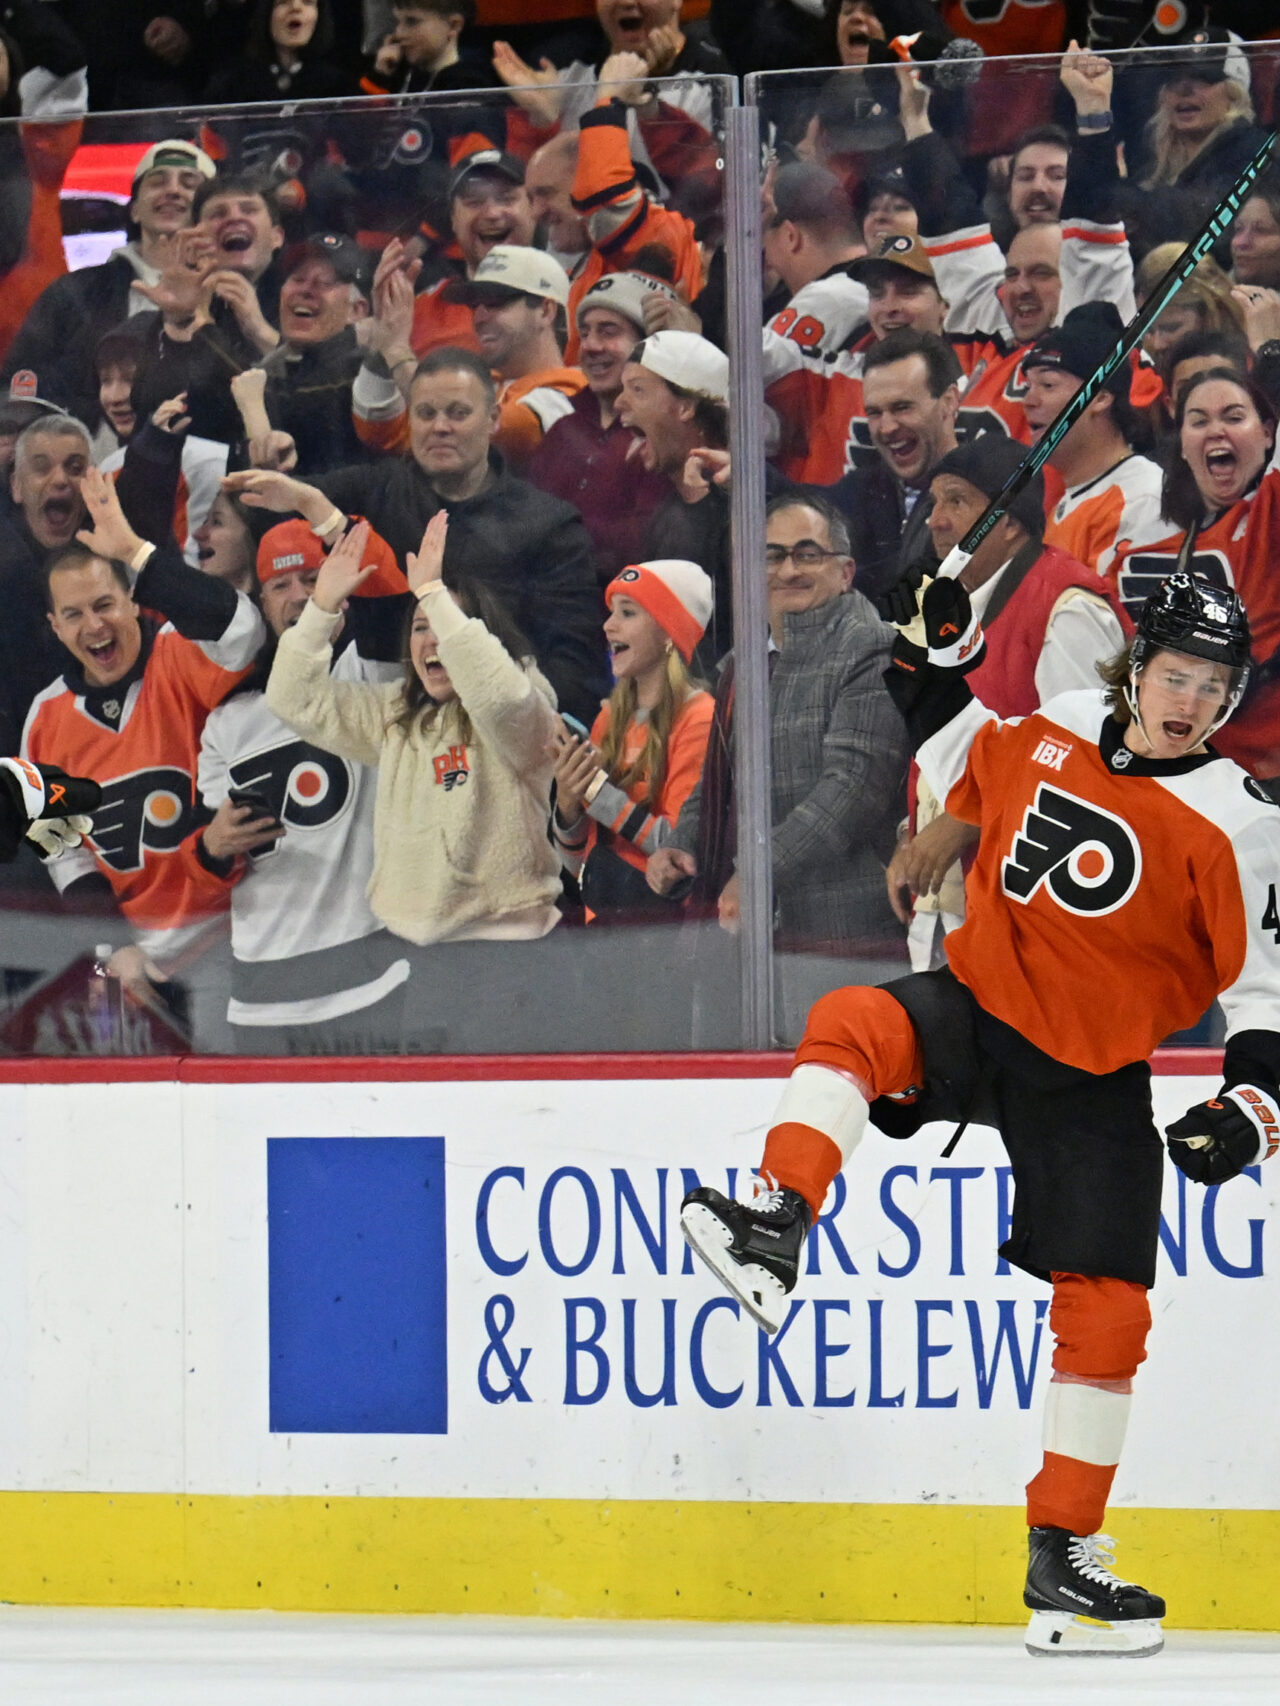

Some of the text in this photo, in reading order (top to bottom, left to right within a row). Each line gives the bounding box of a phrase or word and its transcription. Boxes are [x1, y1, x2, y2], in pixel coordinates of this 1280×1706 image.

[1030, 339, 1124, 477] PULSE
[1202, 602, 1228, 624] 46
[1192, 630, 1229, 646] BAUER
[432, 744, 471, 785] PH
[1031, 740, 1070, 771] IBX
[476, 1167, 858, 1276] CONNR
[477, 1295, 1049, 1410] & BUCKELEW
[1058, 1586, 1094, 1607] BAUER
